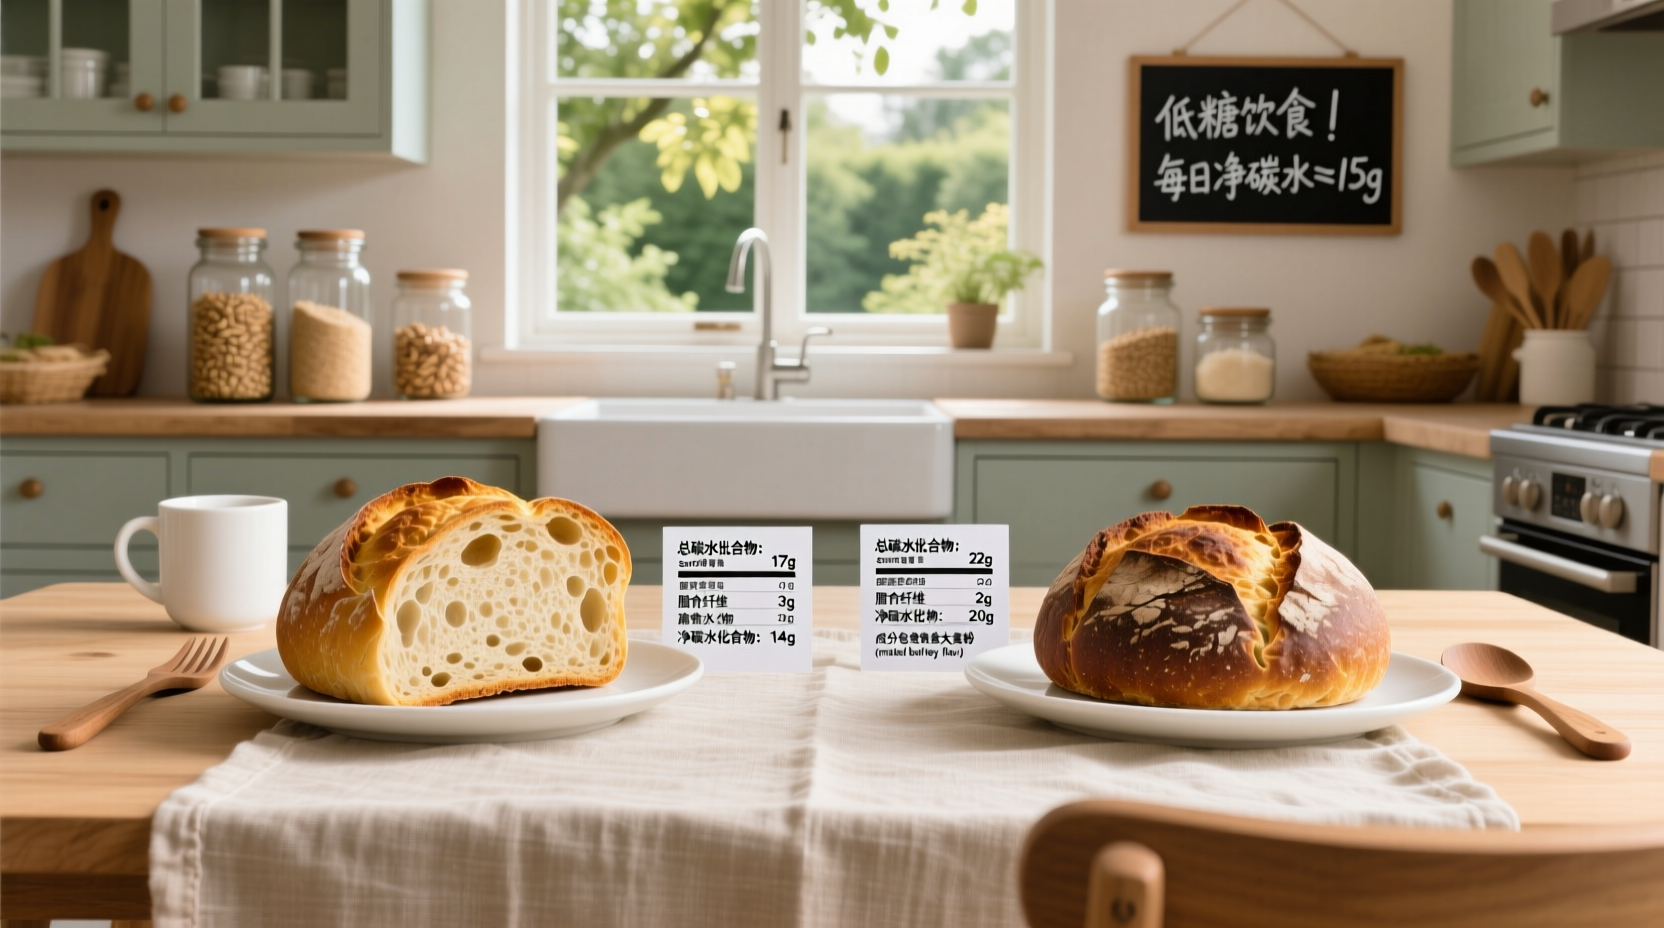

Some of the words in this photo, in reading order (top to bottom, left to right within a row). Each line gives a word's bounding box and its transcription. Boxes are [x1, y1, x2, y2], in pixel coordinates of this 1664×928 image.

[1153, 151, 1383, 205] 每日净碳水=15g
[772, 555, 796, 570] 17g
[969, 552, 992, 567] 22g
[778, 596, 795, 611] 3g
[976, 592, 991, 607] 2g
[969, 610, 994, 625] 20g
[771, 631, 795, 646] 14g
